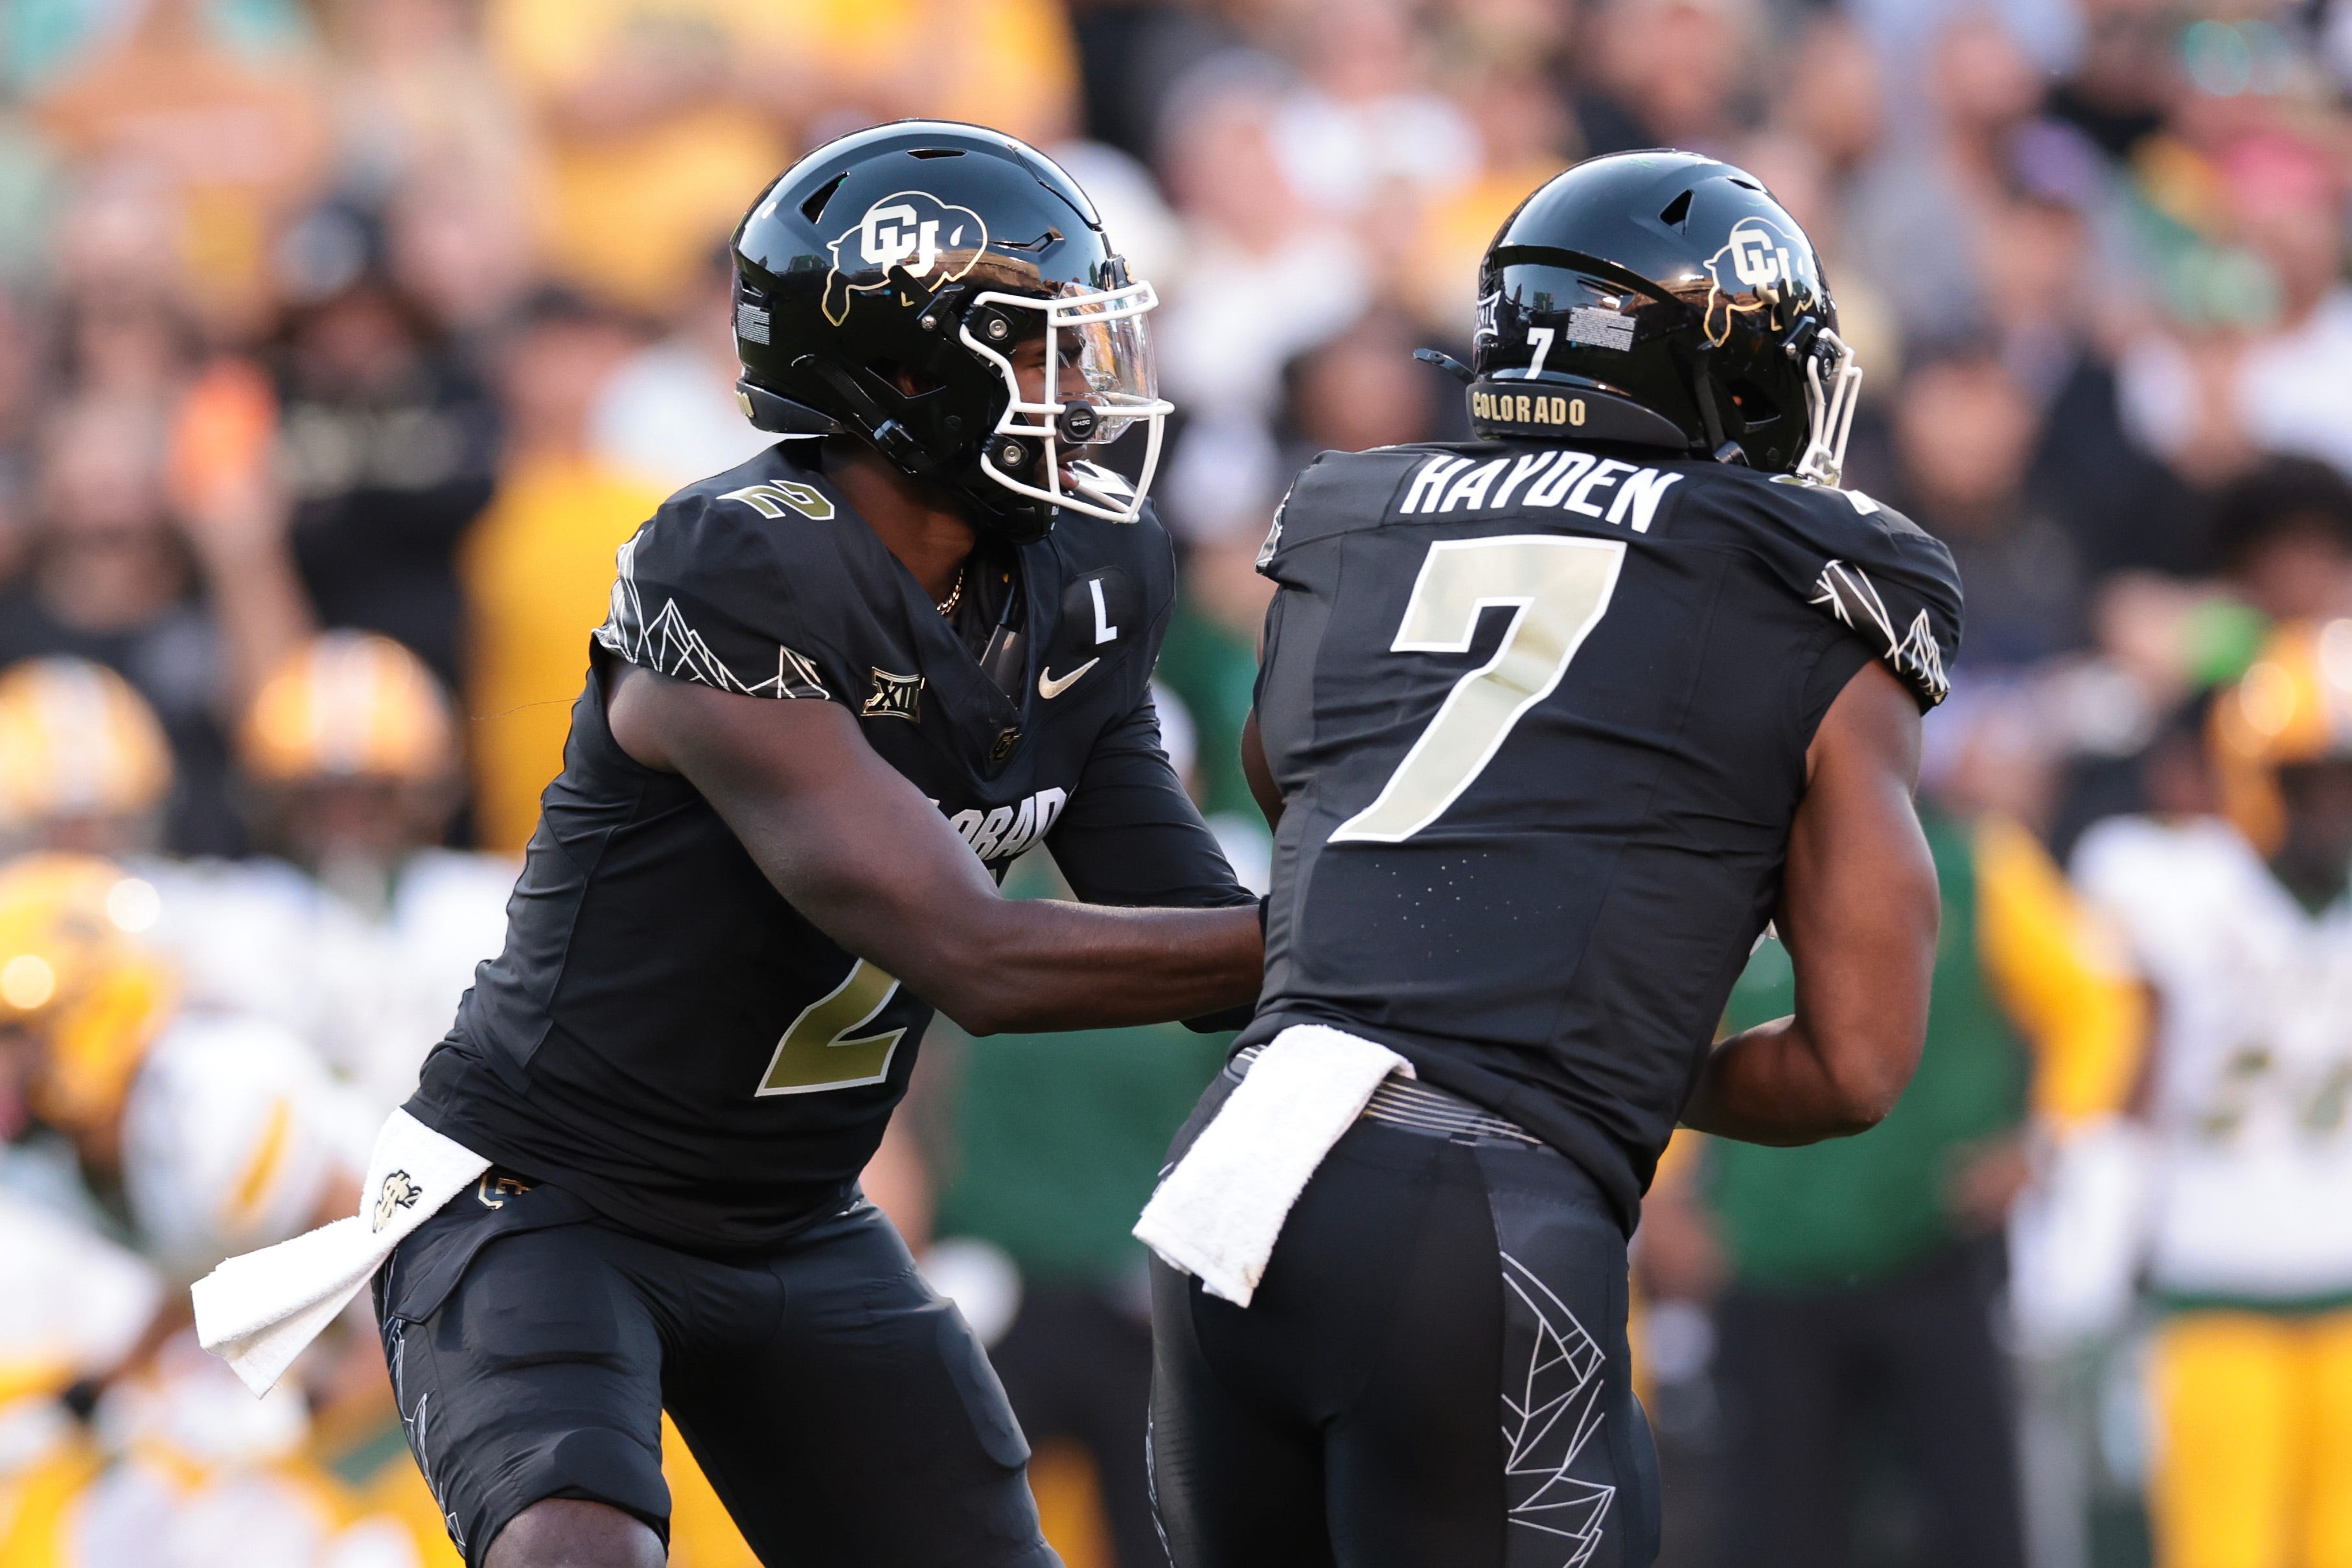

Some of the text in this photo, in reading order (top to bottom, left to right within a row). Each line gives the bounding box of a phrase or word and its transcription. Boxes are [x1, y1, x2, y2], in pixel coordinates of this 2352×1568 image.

[1524, 327, 1555, 380] 7
[1473, 391, 1585, 426] COLORADO
[715, 479, 835, 520] 2
[1400, 451, 1684, 534] HAYDEN
[1089, 579, 1118, 645] L
[1327, 535, 1628, 843] 7
